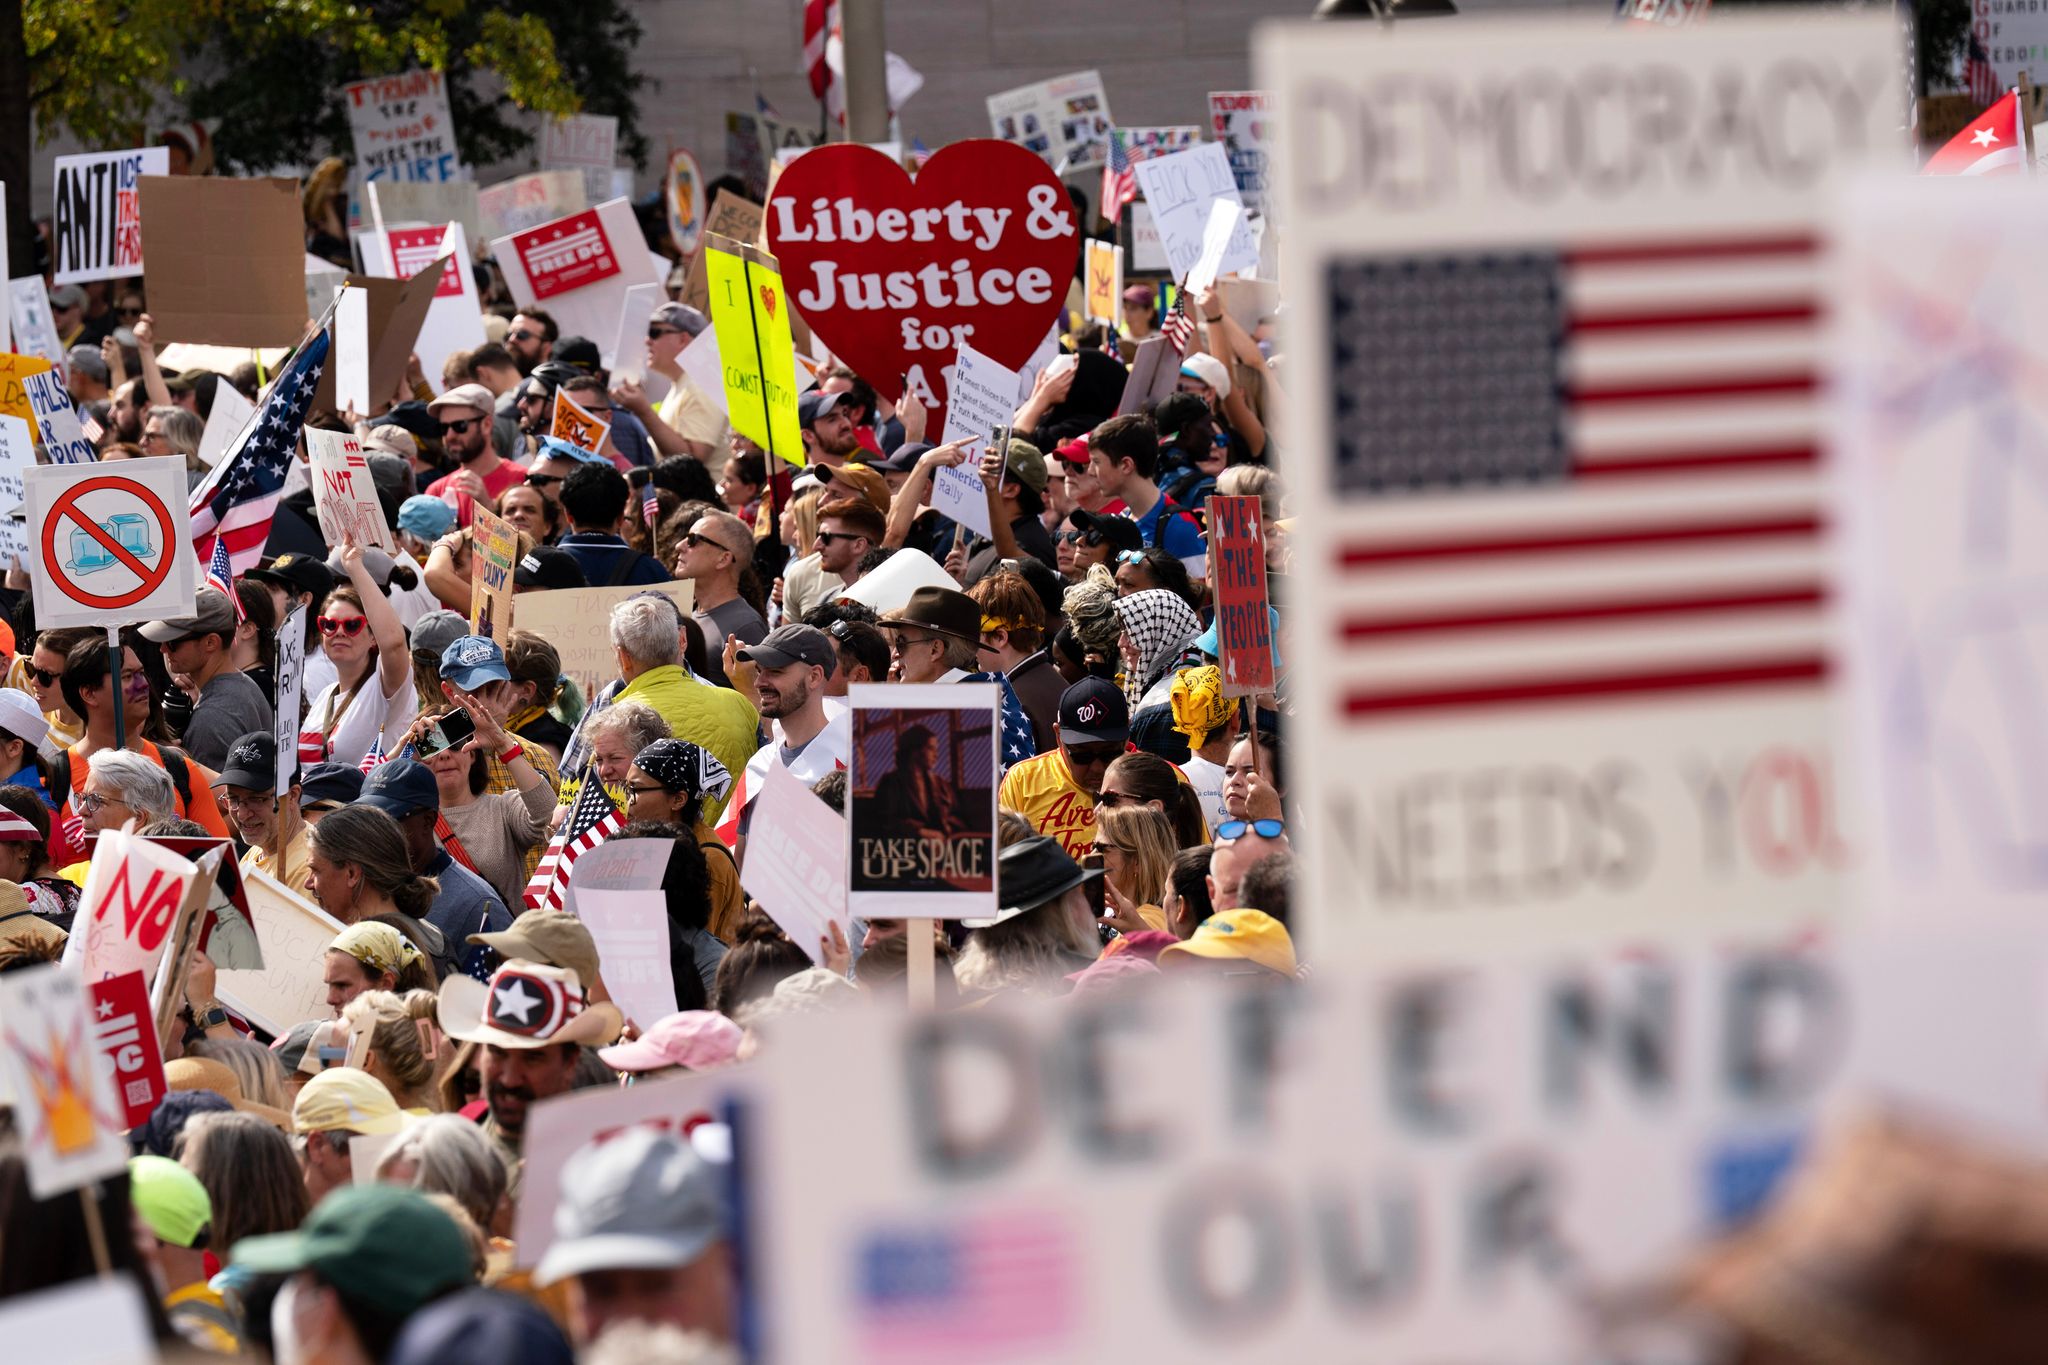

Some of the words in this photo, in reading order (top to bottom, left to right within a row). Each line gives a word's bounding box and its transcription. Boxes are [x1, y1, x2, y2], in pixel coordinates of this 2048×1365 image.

[1295, 60, 1888, 212] DEMOCRACY
[57, 161, 118, 273] ANTI
[771, 196, 1012, 251] Liberty
[1026, 184, 1075, 239] &
[798, 258, 1052, 312] Justice
[901, 317, 975, 350] for
[322, 468, 355, 500] NOT
[938, 478, 963, 504] Rally
[1221, 498, 1248, 538] WE
[1224, 548, 1257, 588] THE
[1221, 600, 1269, 650] PEOPLE
[859, 838, 916, 859] TAKE
[918, 838, 984, 878] SPACE
[1328, 760, 1656, 915] NEEDS
[863, 858, 917, 878] UP
[95, 854, 183, 953] NO
[898, 940, 1852, 1182] DEFEND
[1158, 1150, 1582, 1346] OUR
